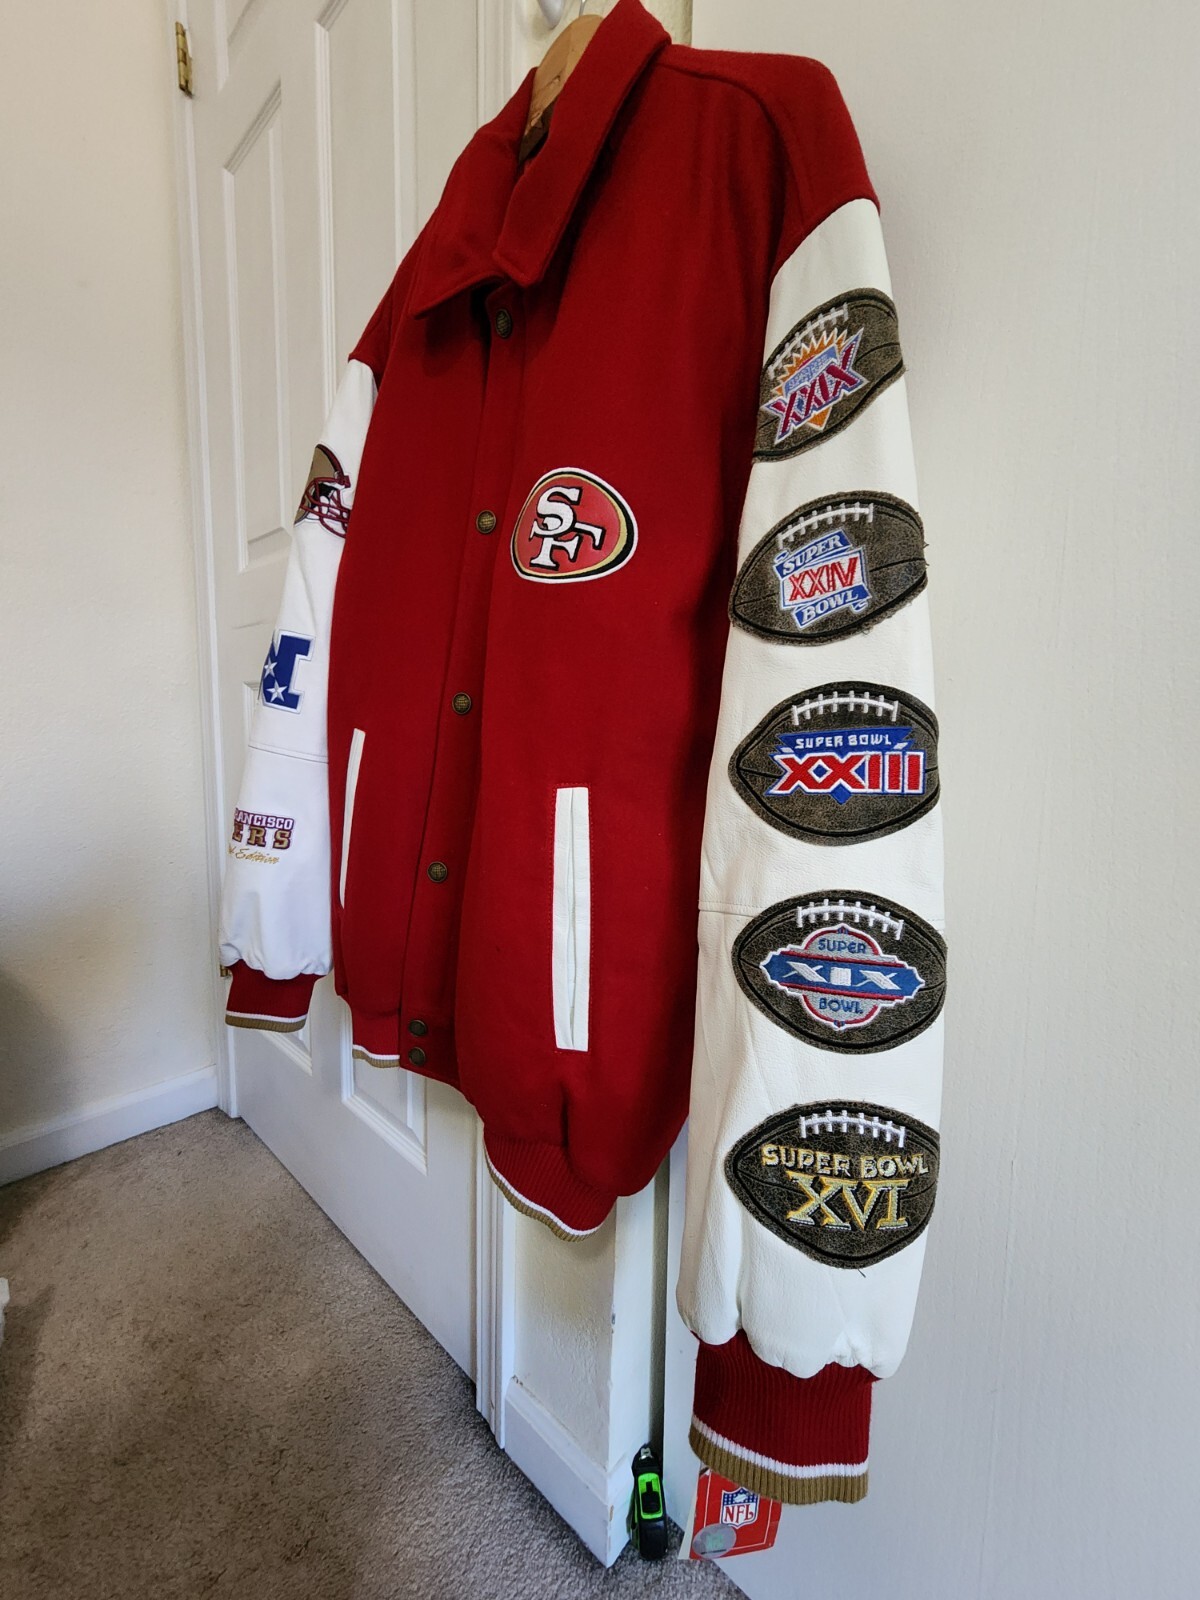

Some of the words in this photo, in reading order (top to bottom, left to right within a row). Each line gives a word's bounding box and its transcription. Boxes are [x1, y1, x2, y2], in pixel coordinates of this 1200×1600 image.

[764, 332, 865, 441] XXIX
[783, 535, 844, 575] SUPER
[789, 557, 858, 602] XXIV
[801, 591, 859, 626] BOWL
[795, 735, 843, 749] SUPER
[847, 734, 892, 746] BOWL
[768, 751, 925, 794] XXIII
[818, 938, 866, 953] SUPER
[781, 961, 902, 990] XIX
[819, 998, 863, 1014] BOWL
[761, 1144, 851, 1177] SUPER
[860, 1153, 929, 1178] BOWL
[786, 1170, 910, 1231] XVI
[723, 1504, 755, 1524] NFL
